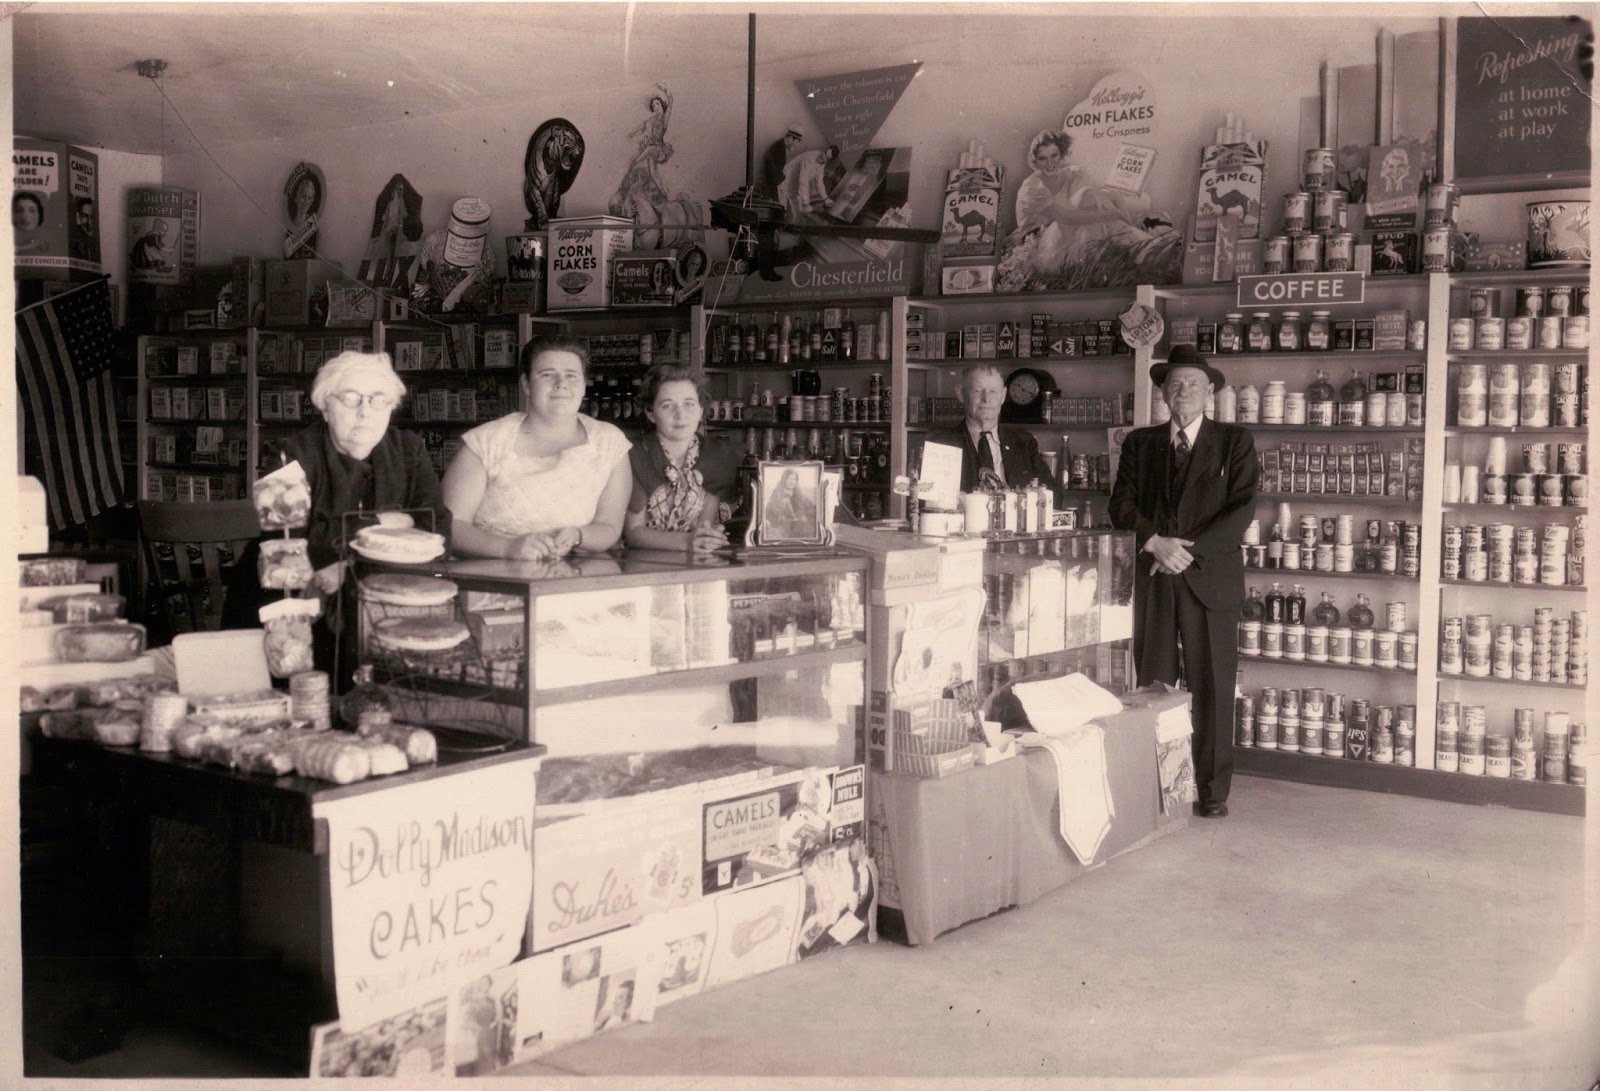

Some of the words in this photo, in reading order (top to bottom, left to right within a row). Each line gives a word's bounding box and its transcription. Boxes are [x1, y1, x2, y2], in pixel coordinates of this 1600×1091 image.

[1475, 31, 1580, 85] Refreshing
[815, 98, 840, 111] makes
[843, 89, 894, 106] Chesterfield
[1091, 85, 1146, 106] Kellogg's
[1499, 88, 1514, 102] at
[1520, 85, 1571, 101] home
[1066, 112, 1101, 128] CORN
[1105, 105, 1154, 123] FLAKES
[1498, 108, 1514, 121] at
[1521, 102, 1569, 118] work
[1092, 127, 1104, 139] for
[1106, 125, 1151, 138] Crispness
[1498, 125, 1514, 138] at
[1520, 121, 1556, 144] play
[70, 160, 94, 176] CAMELS
[1117, 163, 1143, 174] FLAKES
[1120, 157, 1143, 167] CORN
[18, 168, 37, 176] ARE
[1205, 172, 1257, 187] CAMEL
[143, 191, 179, 204] Dutch
[949, 194, 994, 207] CAMEL
[557, 228, 594, 243] Kellogg's
[1377, 232, 1404, 240] STUD
[558, 245, 593, 257] CORN
[553, 257, 597, 271] FLAKES
[616, 262, 649, 277] Camels
[1194, 267, 1213, 275] YOU
[790, 259, 904, 288] Chesterfield
[1254, 279, 1345, 301] COFFEE
[821, 346, 836, 355] Salt
[998, 340, 1013, 350] Salt
[1065, 337, 1076, 356] Salt
[1347, 727, 1367, 741] Salt
[837, 785, 859, 802] MULE
[712, 799, 775, 829] CAMELS
[430, 811, 529, 870] Madison
[547, 866, 639, 934] Duke's
[370, 880, 497, 960] CAKES
